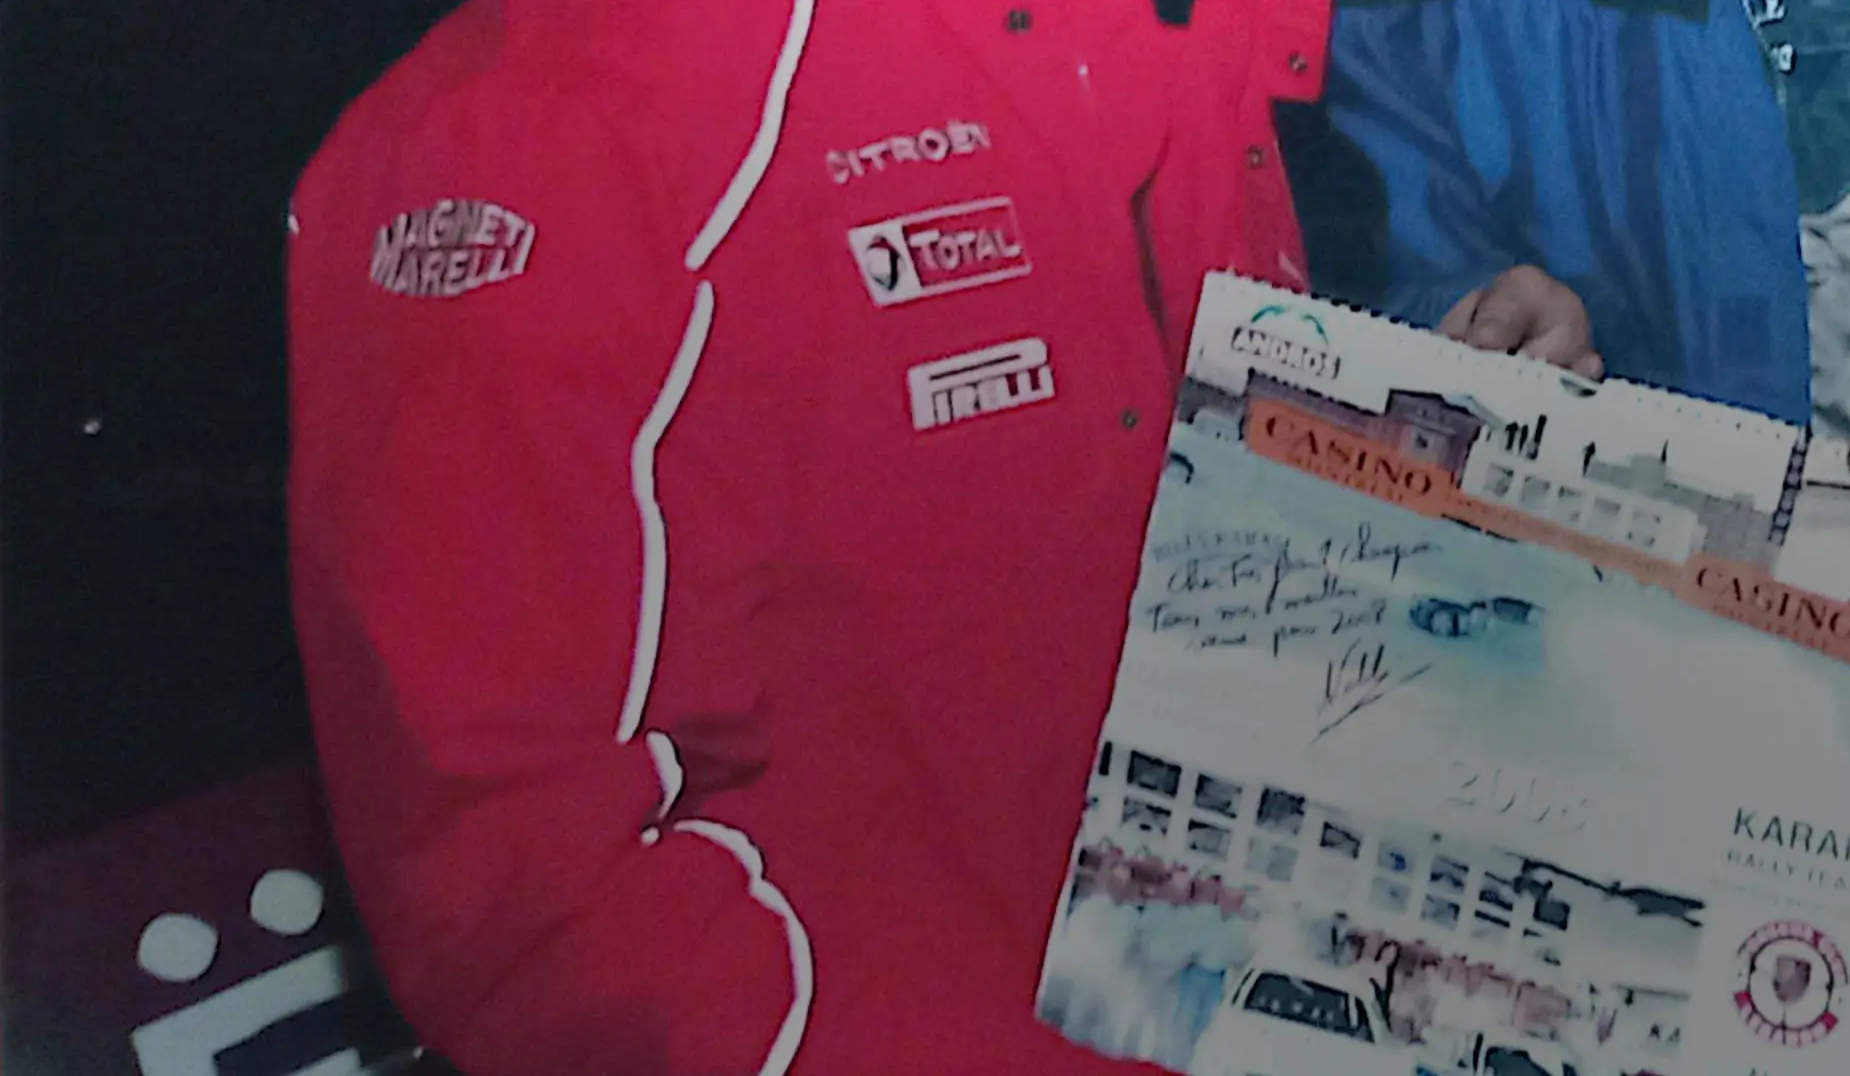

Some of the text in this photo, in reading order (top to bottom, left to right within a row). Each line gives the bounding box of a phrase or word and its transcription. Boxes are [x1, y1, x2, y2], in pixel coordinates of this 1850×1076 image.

[908, 228, 1022, 271] TOTAL
[908, 337, 1055, 431] PIRELLI
[1231, 327, 1340, 379] ANDROS
[1265, 416, 1432, 495] CASINO
